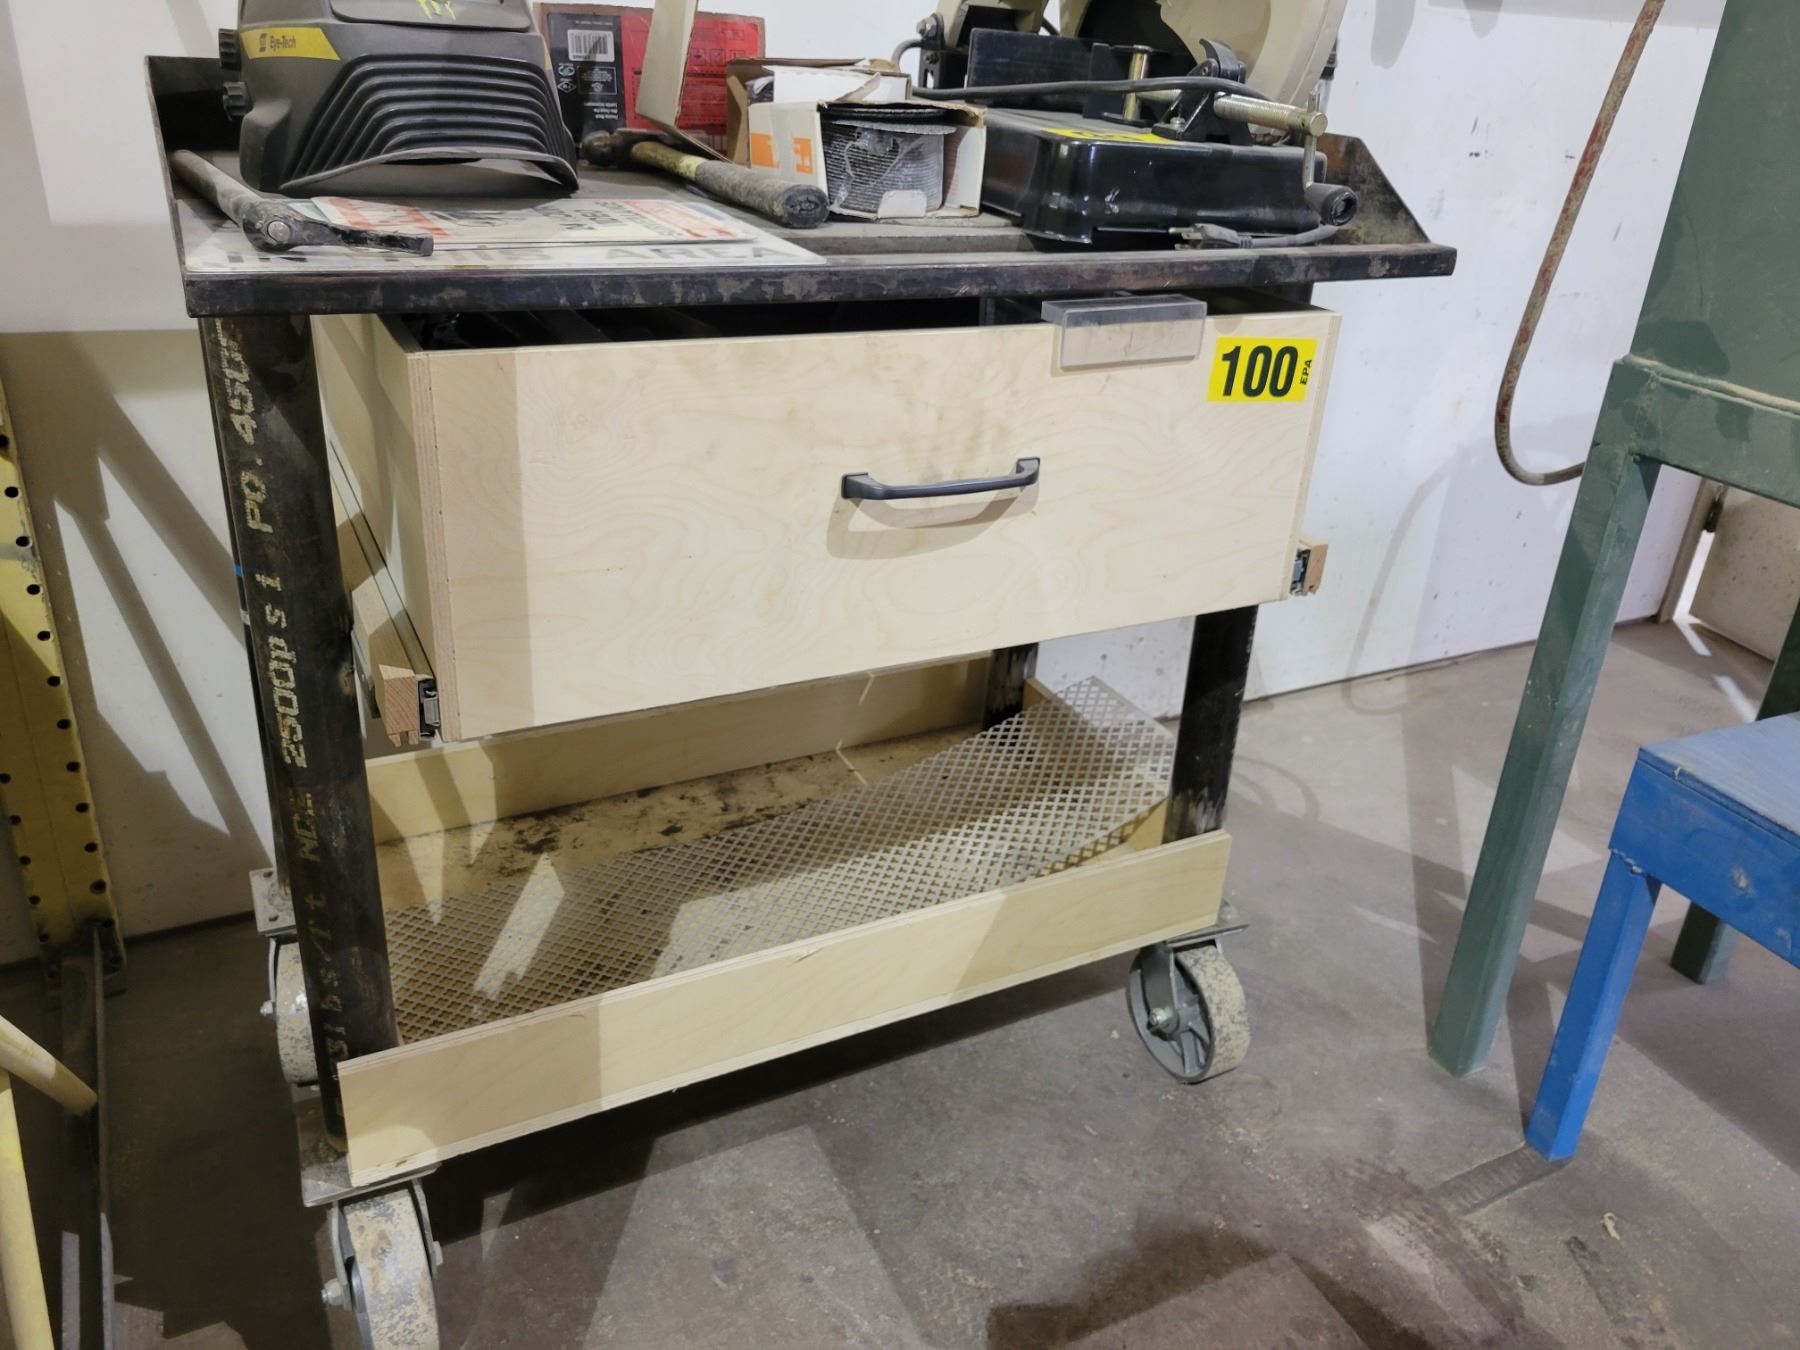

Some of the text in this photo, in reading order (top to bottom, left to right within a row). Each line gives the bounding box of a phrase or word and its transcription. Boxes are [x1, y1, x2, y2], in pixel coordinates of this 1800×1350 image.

[270, 34, 297, 51] Eye-Tech
[606, 247, 800, 260] AREA
[1221, 345, 1299, 398] 100
[1299, 359, 1313, 385] EPA
